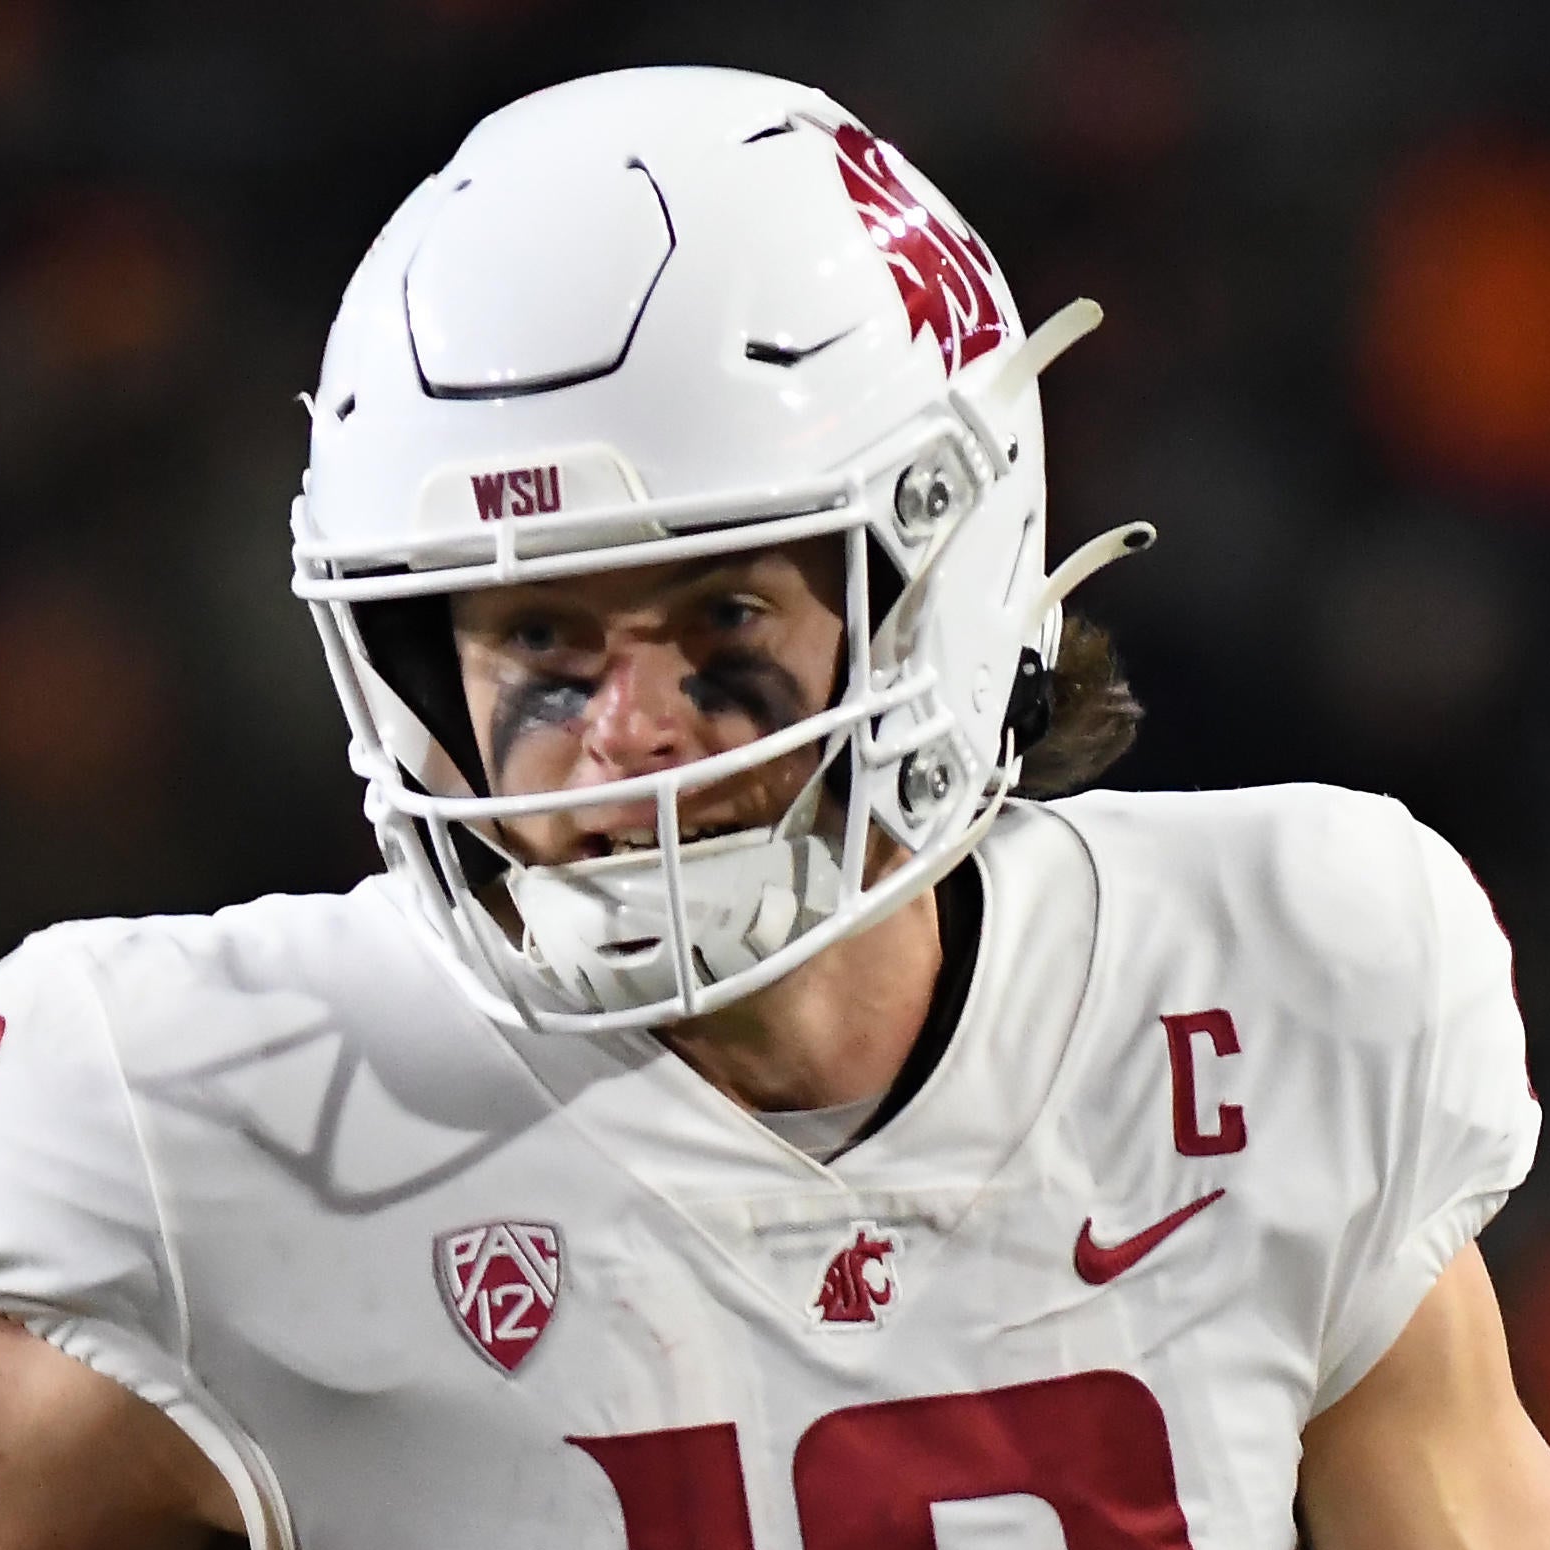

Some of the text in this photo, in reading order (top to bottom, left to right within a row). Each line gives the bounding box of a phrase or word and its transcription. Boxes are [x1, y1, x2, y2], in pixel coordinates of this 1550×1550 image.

[470, 464, 561, 521] WSU
[1160, 1008, 1247, 1157] C
[446, 1224, 558, 1317] PAC
[477, 1283, 539, 1343] 12
